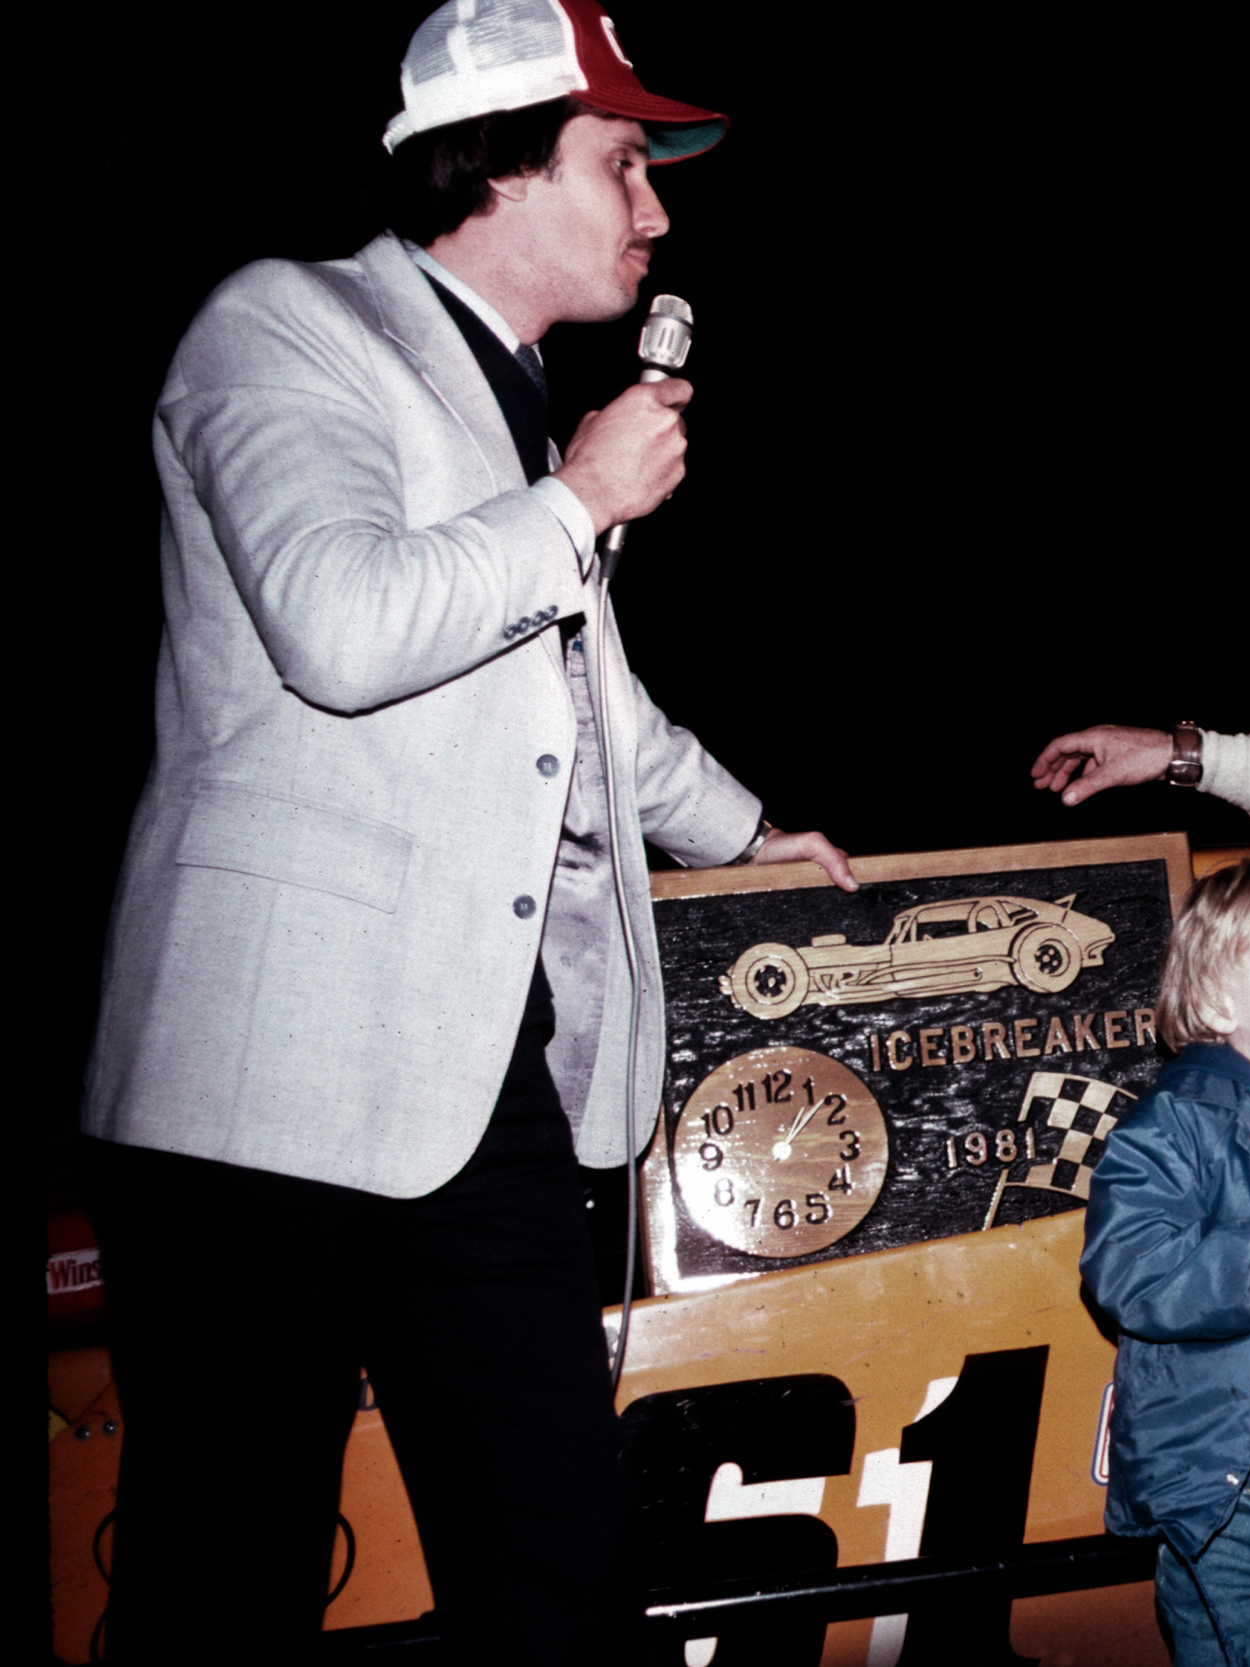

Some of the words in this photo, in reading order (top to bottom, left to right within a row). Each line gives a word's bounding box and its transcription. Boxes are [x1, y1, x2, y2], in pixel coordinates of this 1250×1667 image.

[869, 1008, 1157, 1072] ICEBREAKER
[732, 1080, 756, 1112] 11
[762, 1068, 793, 1104] 12
[803, 1074, 815, 1106] 1
[701, 1102, 734, 1138] 10
[824, 1093, 848, 1126] 2
[699, 1142, 724, 1171] 9
[839, 1130, 861, 1162] 3
[947, 1127, 1036, 1168] 1981
[714, 1177, 736, 1207] 8
[828, 1164, 855, 1194] 4
[744, 1197, 764, 1228] 7
[773, 1199, 800, 1230] 6
[805, 1192, 832, 1225] 5
